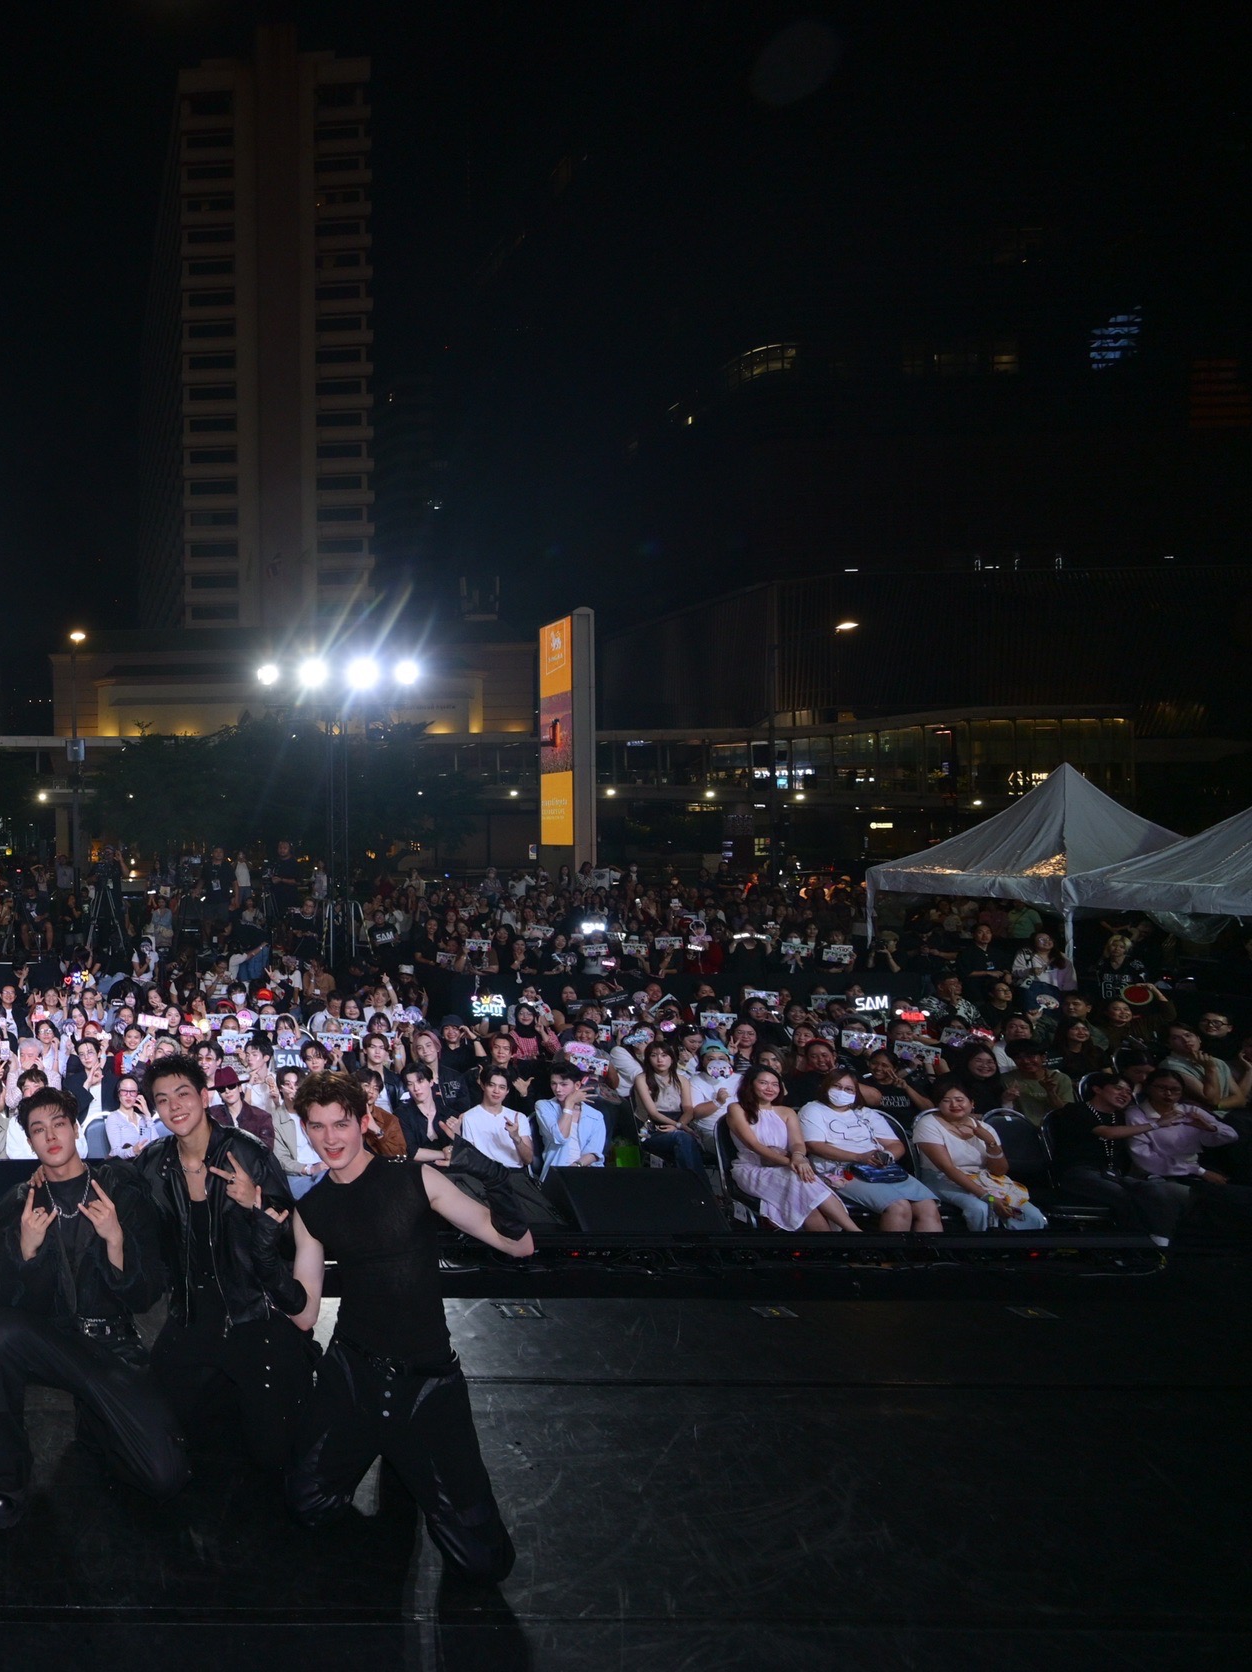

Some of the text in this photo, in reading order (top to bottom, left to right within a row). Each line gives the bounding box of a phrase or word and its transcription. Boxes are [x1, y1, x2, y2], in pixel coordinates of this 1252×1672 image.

[375, 931, 395, 942] SAM
[472, 1001, 504, 1015] Sam
[854, 995, 889, 1011] SAM
[276, 1054, 307, 1068] SAM
